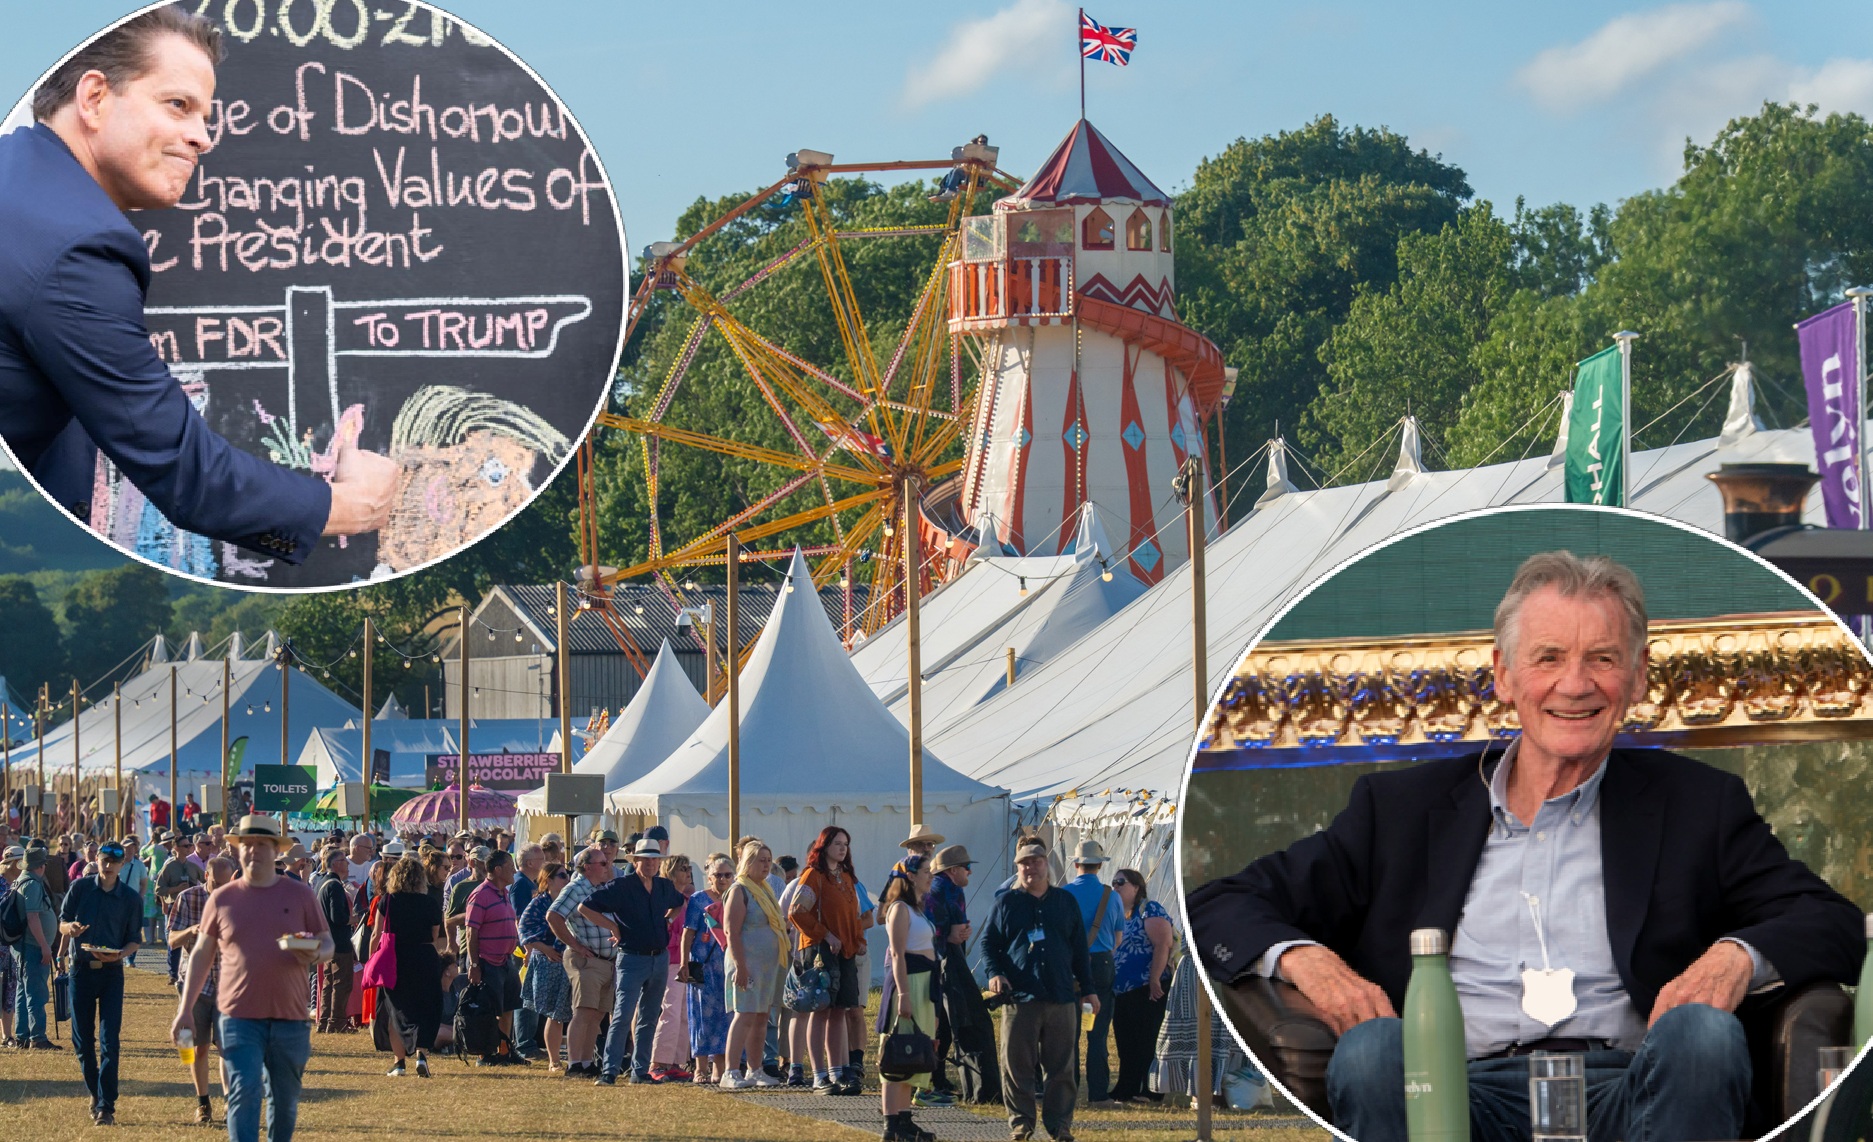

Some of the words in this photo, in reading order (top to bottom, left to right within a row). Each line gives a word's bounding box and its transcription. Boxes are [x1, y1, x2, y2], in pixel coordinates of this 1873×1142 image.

[207, 98, 259, 150] ge
[267, 61, 326, 141] of
[373, 146, 536, 211] Values
[189, 211, 444, 272] President
[196, 316, 287, 361] FDR
[404, 308, 548, 350] TRUMP
[1822, 352, 1862, 530] elyn
[263, 784, 308, 793] TOILETS
[458, 767, 551, 781] HOCOLAT
